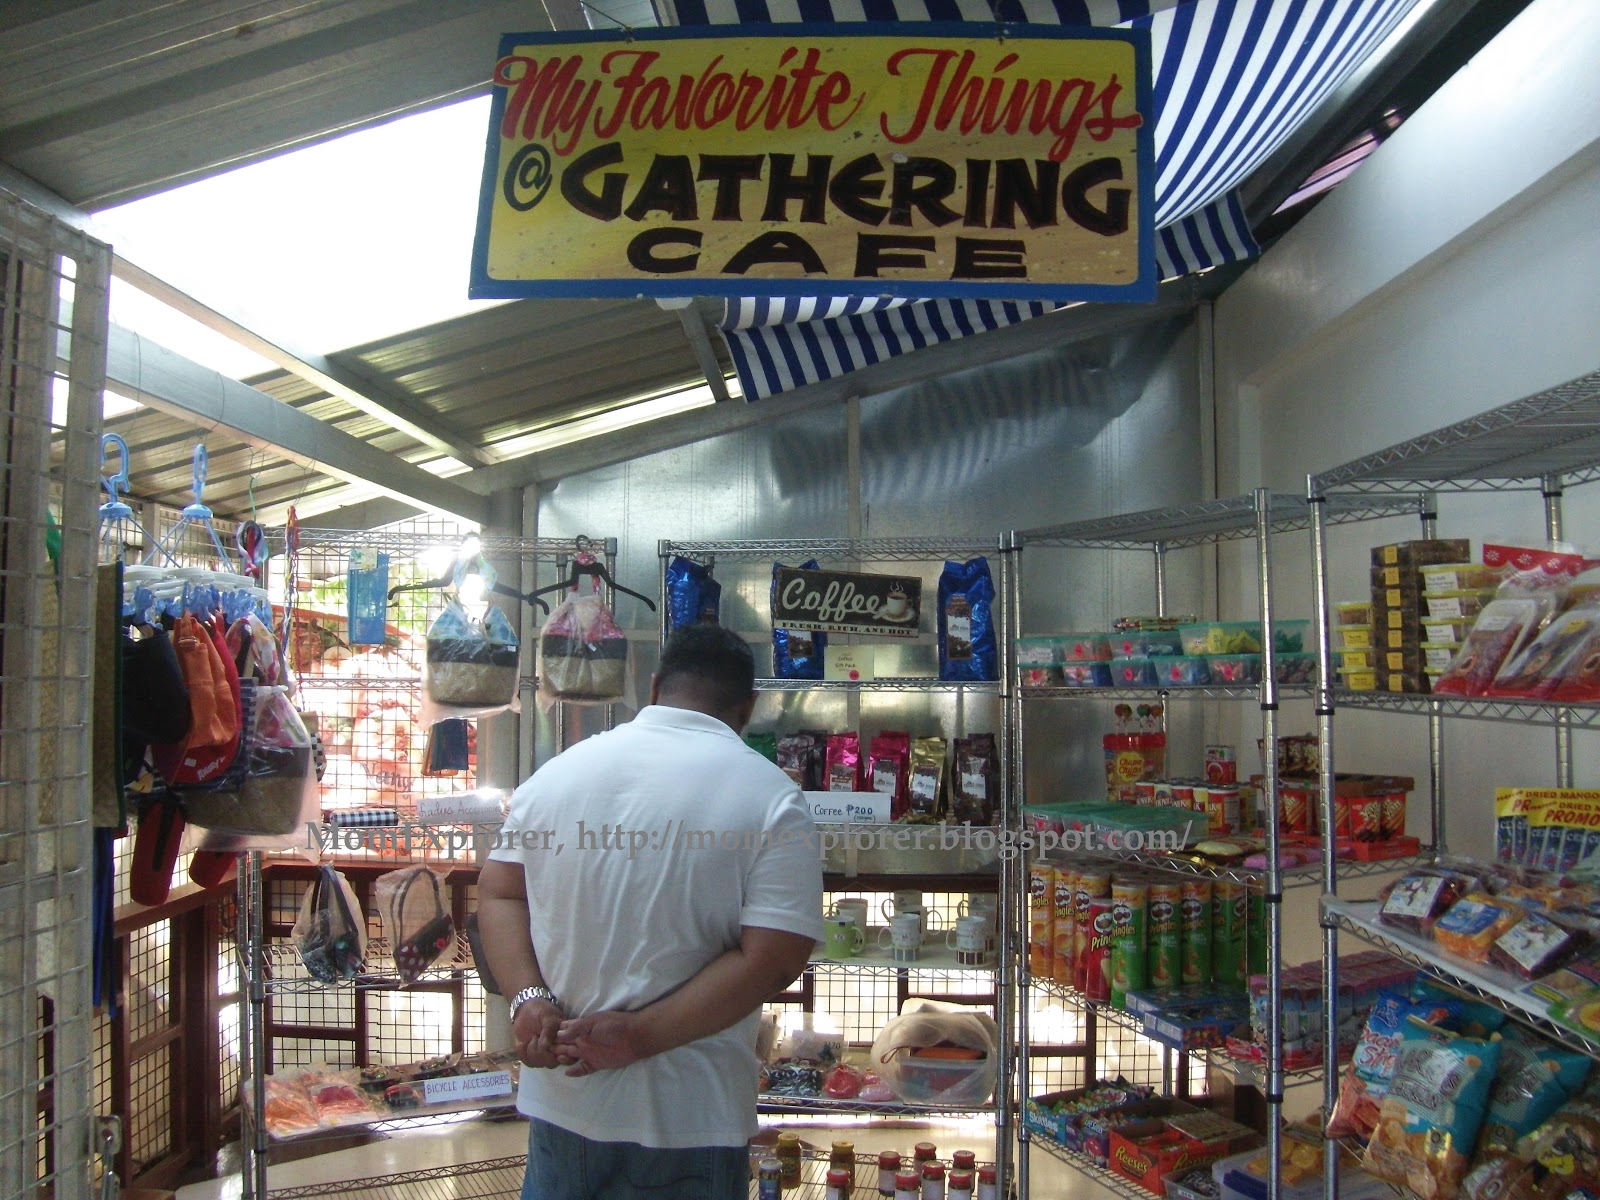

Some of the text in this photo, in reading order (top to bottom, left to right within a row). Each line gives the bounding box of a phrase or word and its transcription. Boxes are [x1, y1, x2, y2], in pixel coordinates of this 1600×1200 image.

[493, 46, 1143, 161] My Favorite Things
[560, 140, 1132, 236] GATHERING
[627, 227, 1028, 278] CAFE
[782, 578, 885, 621] Coffee
[419, 801, 453, 818] Ladies
[1544, 809, 1600, 826] PROMO
[1559, 802, 1591, 810] DRIED
[426, 1074, 510, 1094] BICYCLE ACCESSORIES
[1115, 1145, 1148, 1173] Reese's
